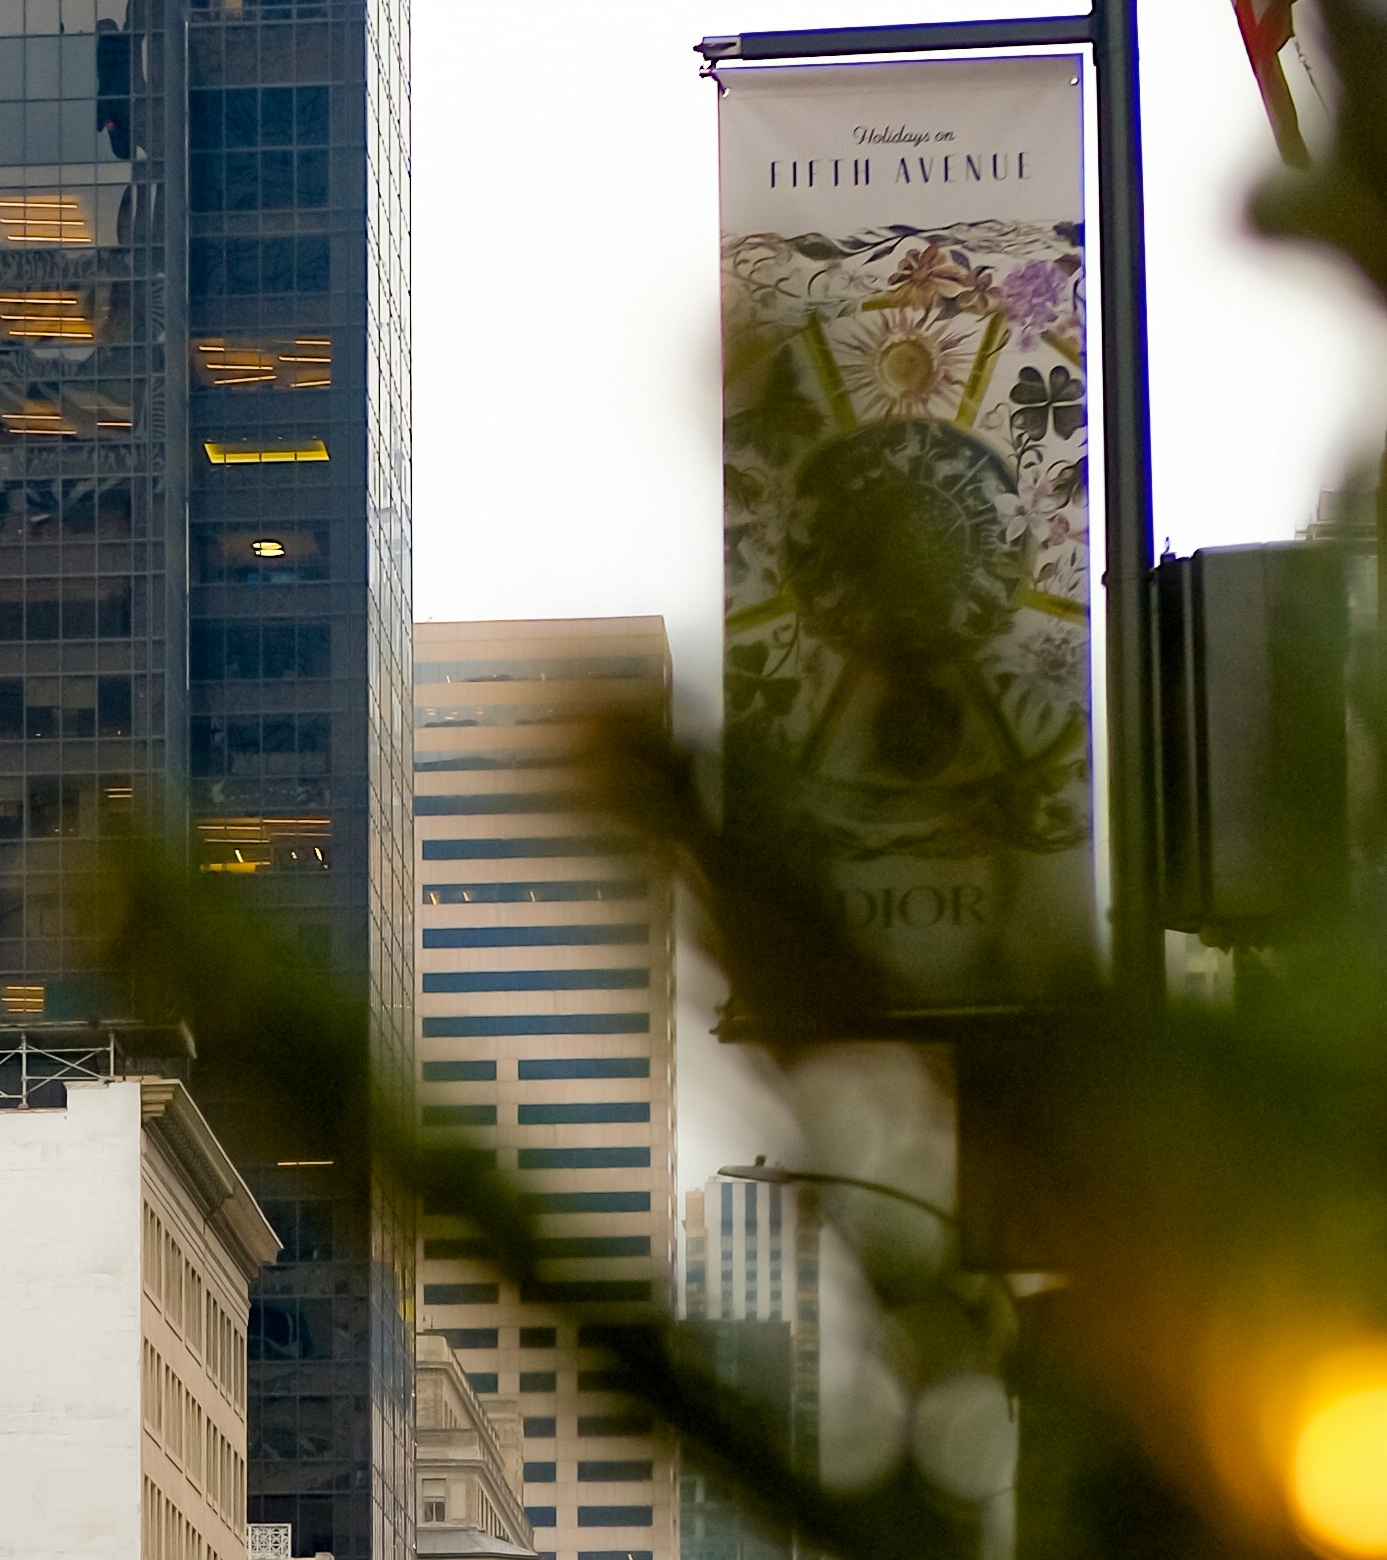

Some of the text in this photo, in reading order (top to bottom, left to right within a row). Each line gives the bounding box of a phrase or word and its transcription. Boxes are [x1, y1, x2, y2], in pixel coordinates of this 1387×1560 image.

[852, 125, 957, 148] Holidays on
[769, 151, 1033, 189] FIFTH AVENUE
[839, 886, 985, 929] DIOR
